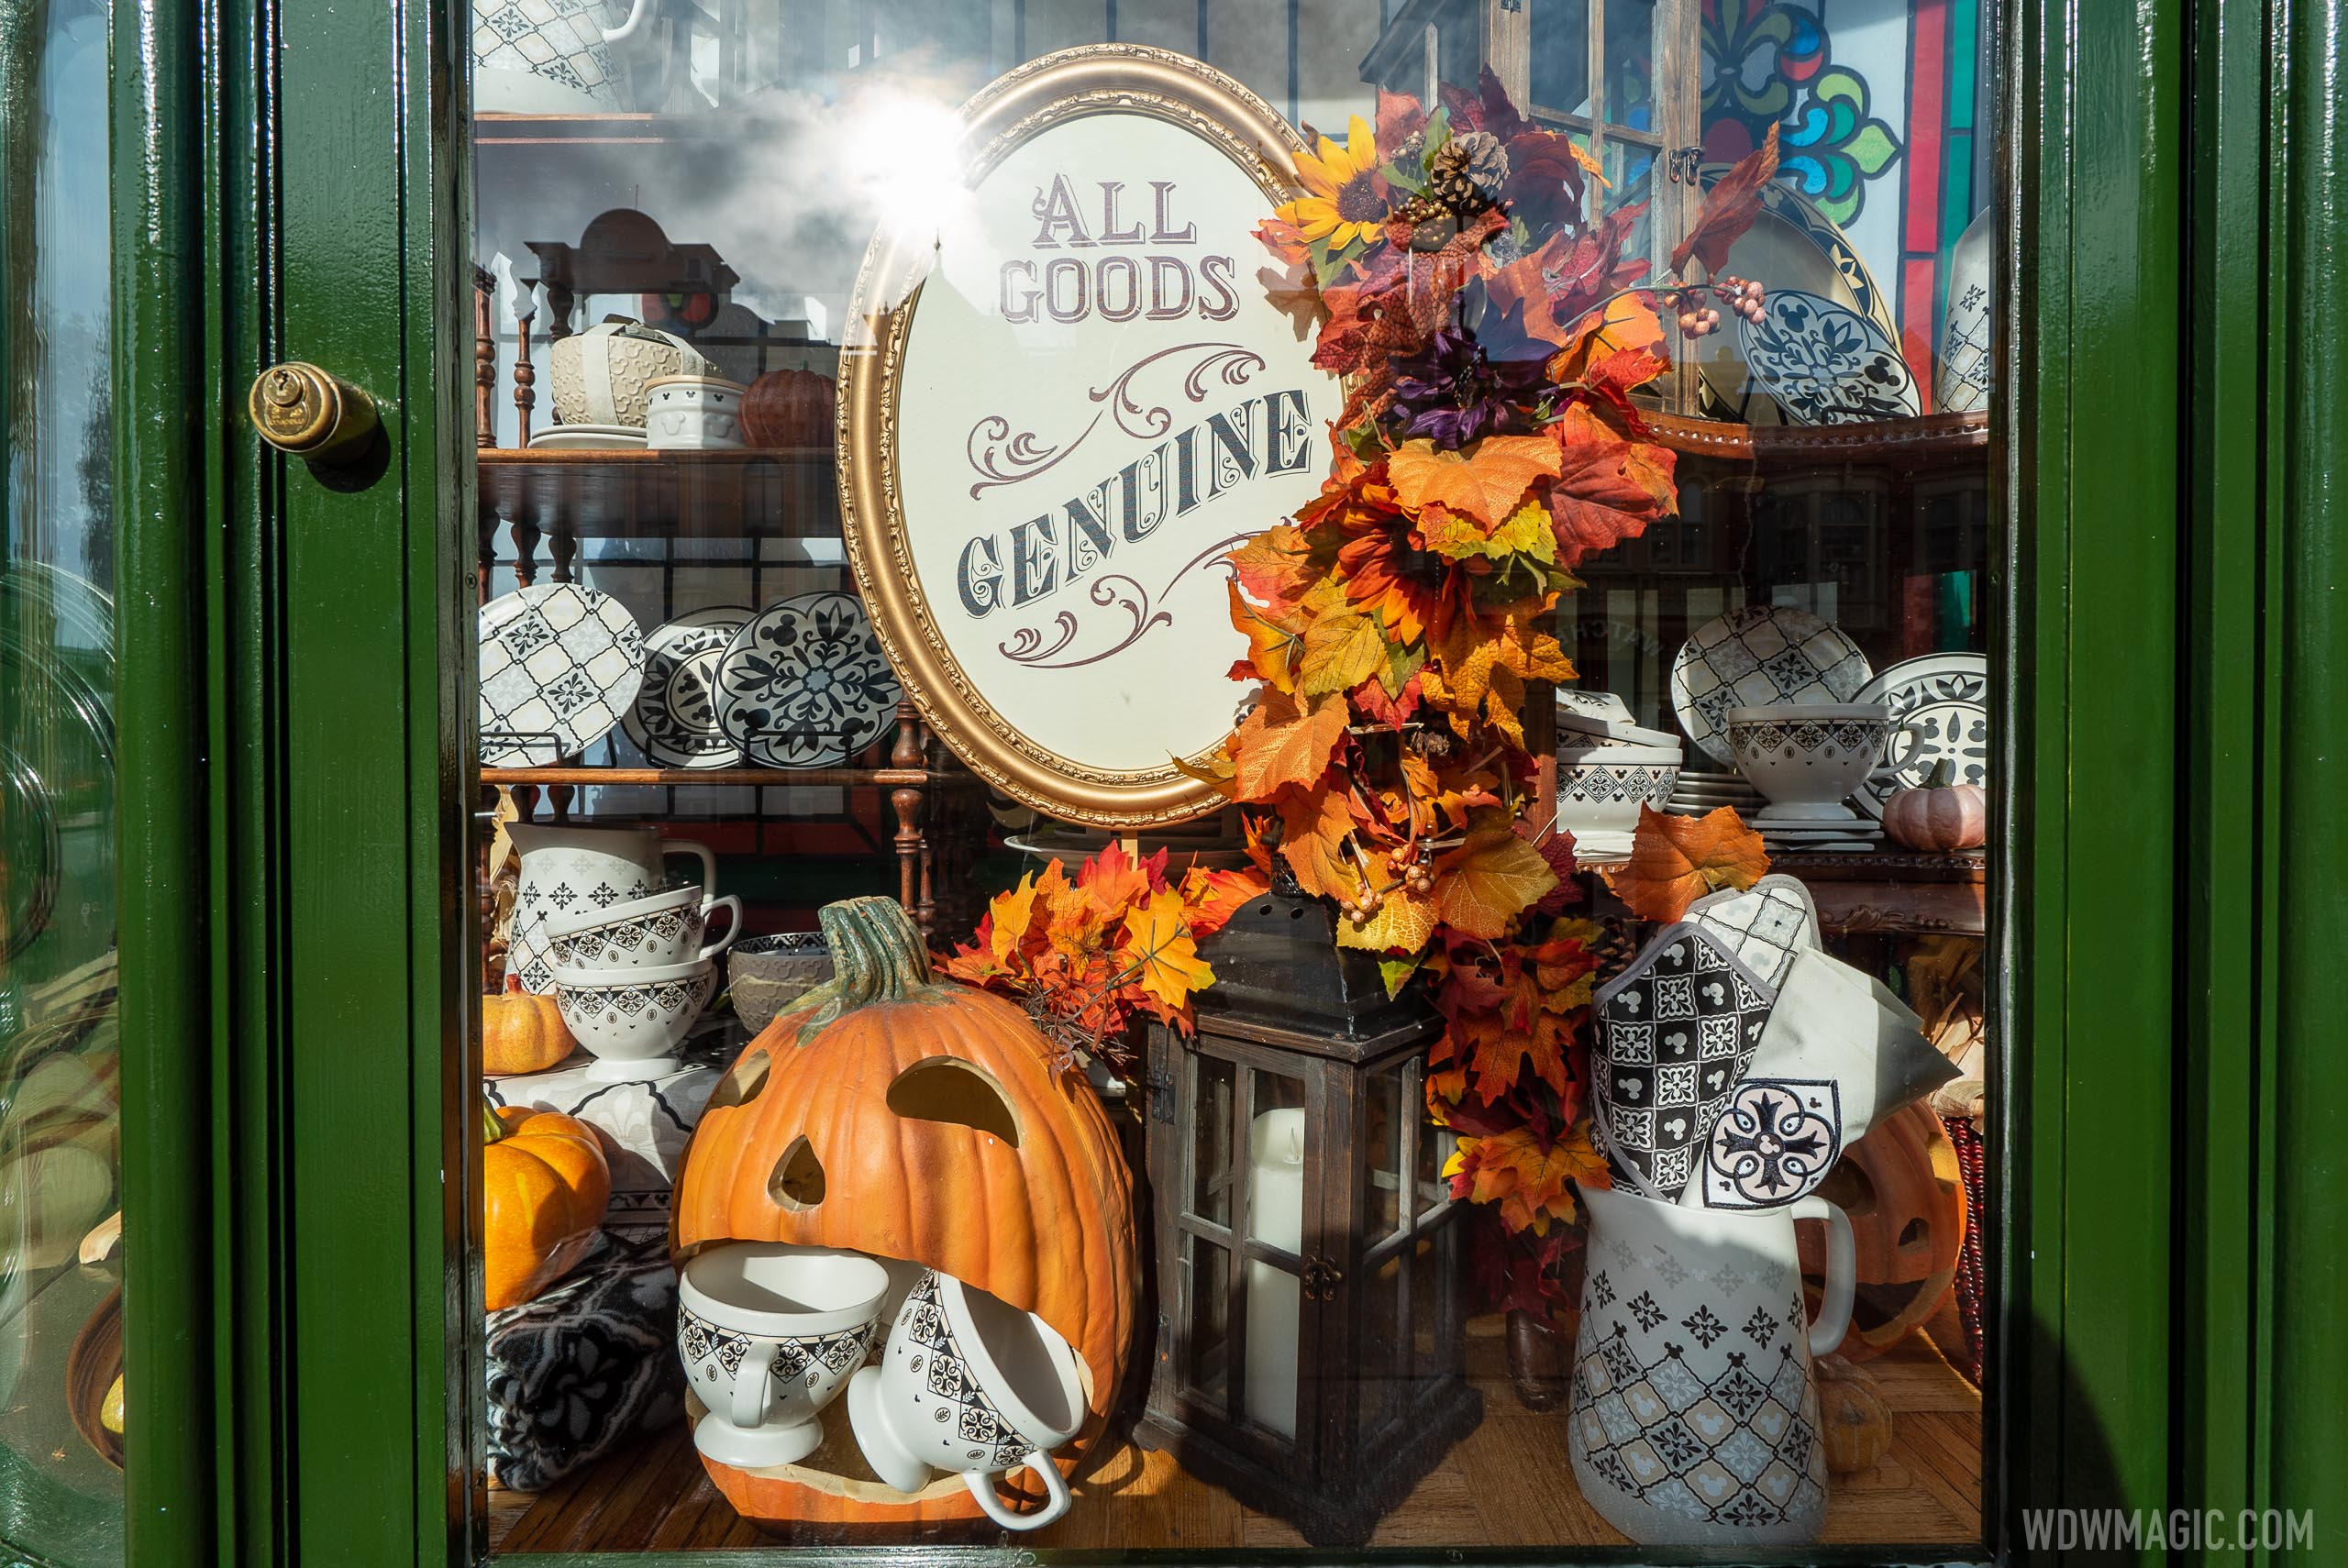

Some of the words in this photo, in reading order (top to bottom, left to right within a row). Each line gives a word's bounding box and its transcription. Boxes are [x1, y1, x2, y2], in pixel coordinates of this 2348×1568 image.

[1032, 172, 1197, 249] ALL
[999, 255, 1239, 325] GOODS
[957, 389, 1312, 620] GENUINE
